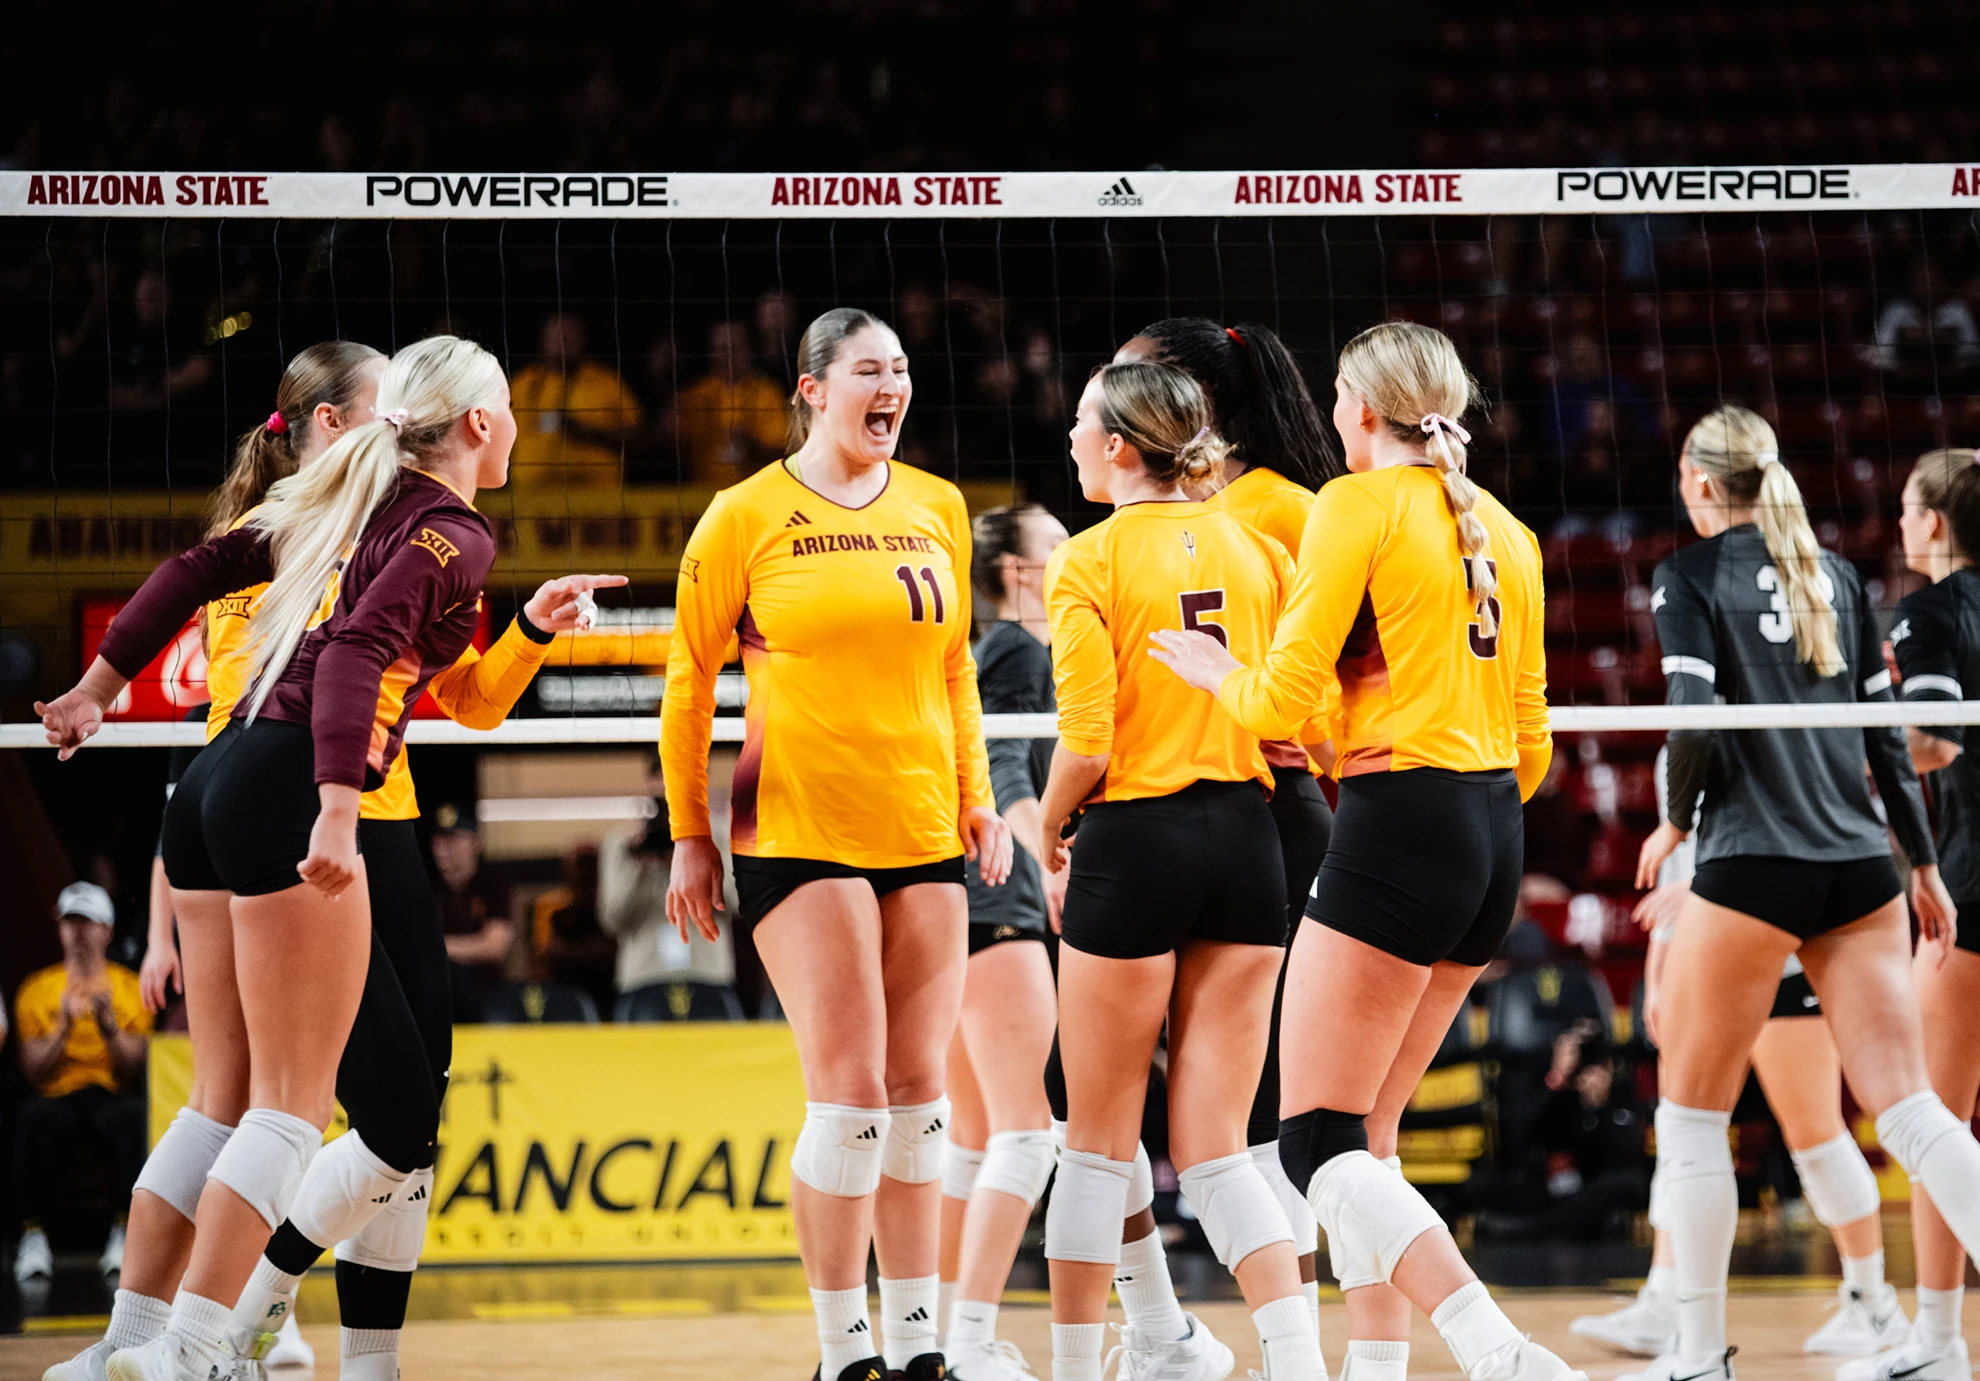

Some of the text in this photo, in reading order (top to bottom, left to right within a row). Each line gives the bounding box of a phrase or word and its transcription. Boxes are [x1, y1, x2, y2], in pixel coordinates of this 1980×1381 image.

[27, 175, 269, 206] ARIZONA STATE
[366, 176, 668, 207] POWERADE
[772, 176, 1002, 206] ARIZONA STATE
[1098, 194, 1143, 206] adidas
[1234, 174, 1463, 204] ARIZONA STATE
[1557, 169, 1849, 201] POWERADE
[793, 534, 935, 557] ARIZONA STATE
[895, 564, 945, 625] 11
[1178, 588, 1229, 650] 5
